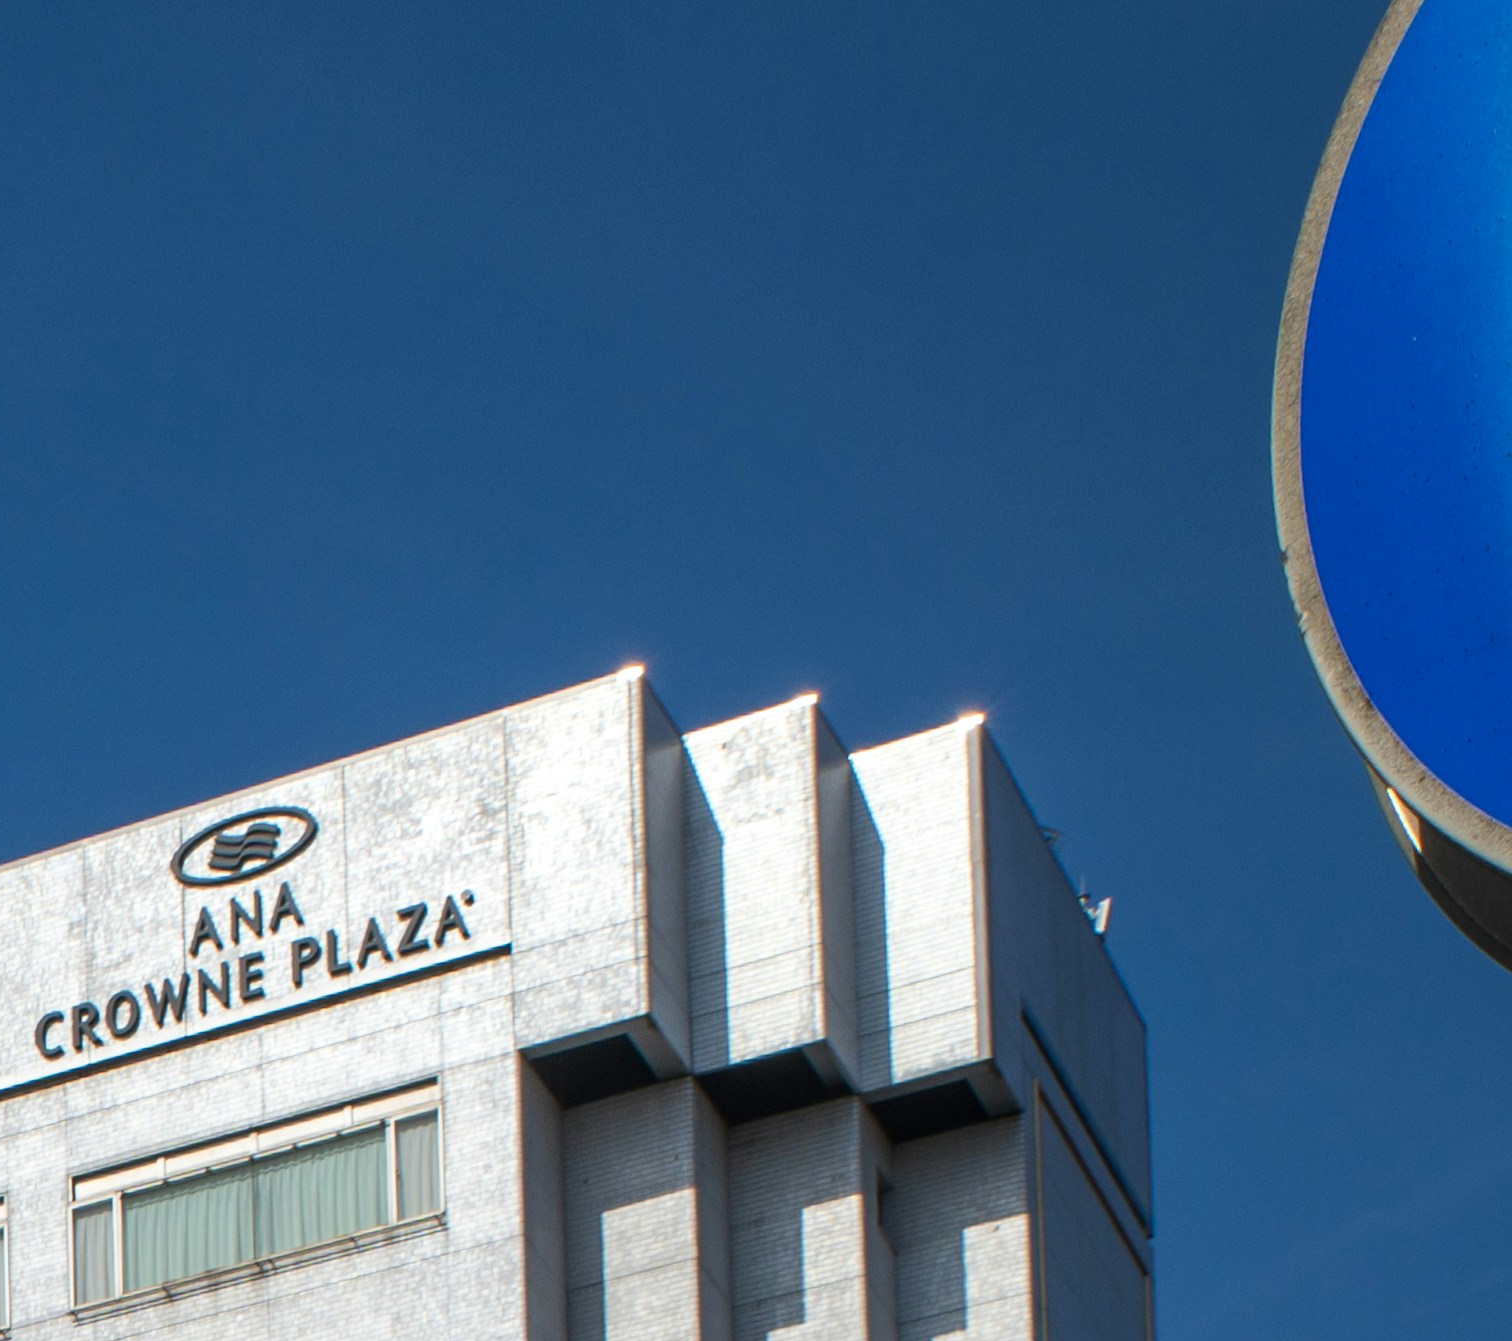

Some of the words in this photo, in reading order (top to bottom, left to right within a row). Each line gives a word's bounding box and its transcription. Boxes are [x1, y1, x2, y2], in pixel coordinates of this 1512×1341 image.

[34, 950, 267, 1060] CROWNE
[290, 893, 471, 989] PLAZA
[190, 881, 304, 958] ANA
